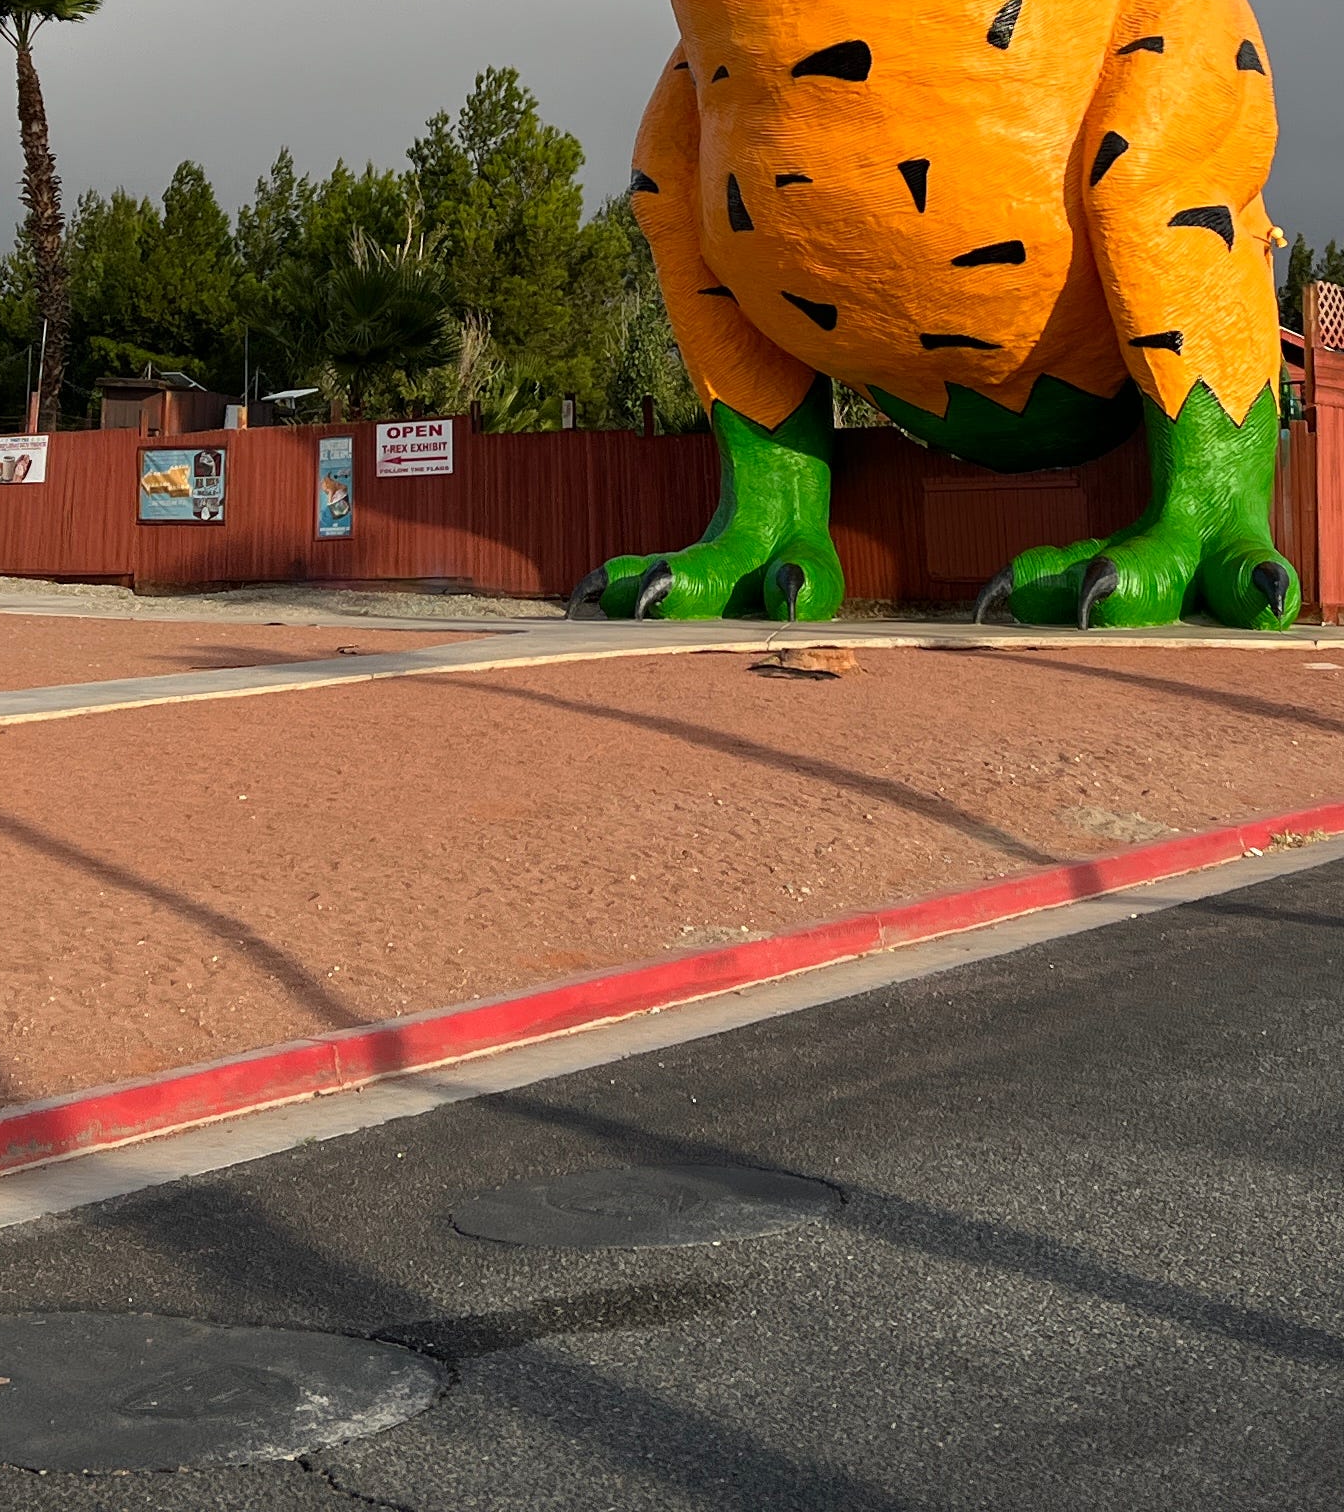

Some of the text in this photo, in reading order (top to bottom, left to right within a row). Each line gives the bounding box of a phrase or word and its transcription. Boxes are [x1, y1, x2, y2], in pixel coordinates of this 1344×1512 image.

[387, 424, 442, 439] OPEN
[382, 442, 447, 454] T-REX EXHIBIT
